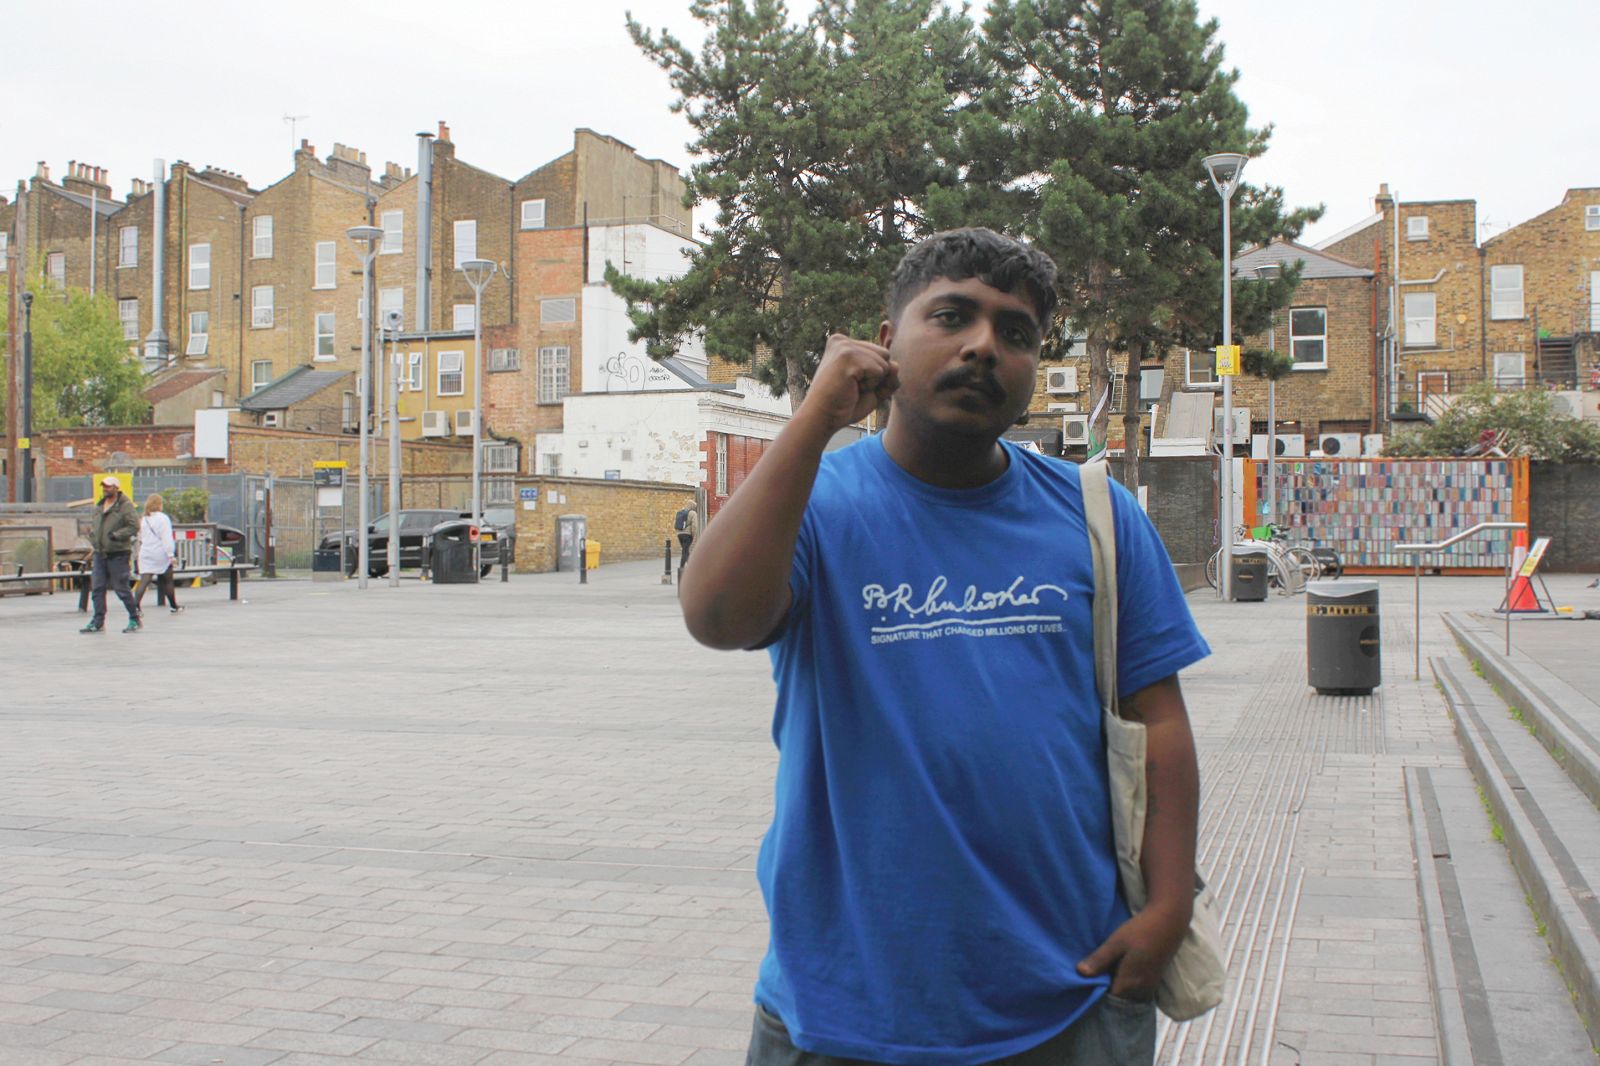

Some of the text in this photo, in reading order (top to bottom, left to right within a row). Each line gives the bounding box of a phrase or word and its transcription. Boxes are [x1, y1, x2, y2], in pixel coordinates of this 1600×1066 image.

[871, 631, 920, 644] SIGNATURE
[922, 628, 942, 640] THAT
[945, 626, 984, 637] CHANGED
[985, 625, 1025, 637] MILLIONS
[1027, 623, 1038, 633] OF
